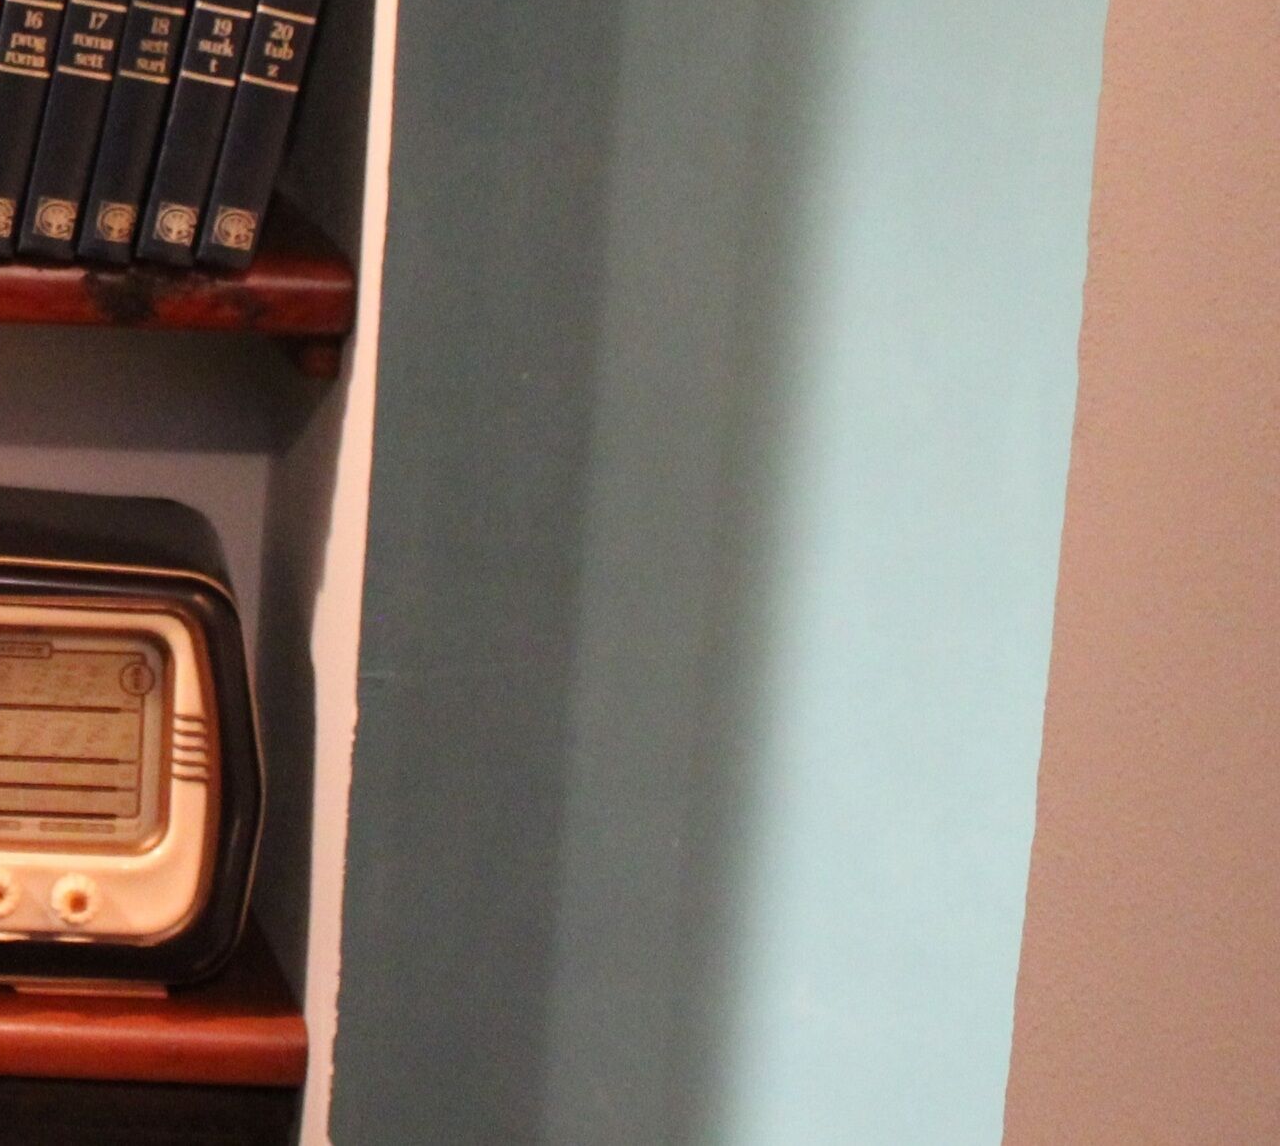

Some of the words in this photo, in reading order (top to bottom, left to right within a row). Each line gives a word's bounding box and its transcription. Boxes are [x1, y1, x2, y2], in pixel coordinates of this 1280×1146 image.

[24, 9, 43, 30] 16
[89, 12, 108, 30] 17
[151, 17, 170, 35] 18
[213, 18, 233, 36] 19
[270, 21, 294, 40] 20
[11, 32, 47, 52] prog
[73, 33, 114, 51] roma
[264, 41, 294, 61] tub
[5, 51, 46, 68] roma
